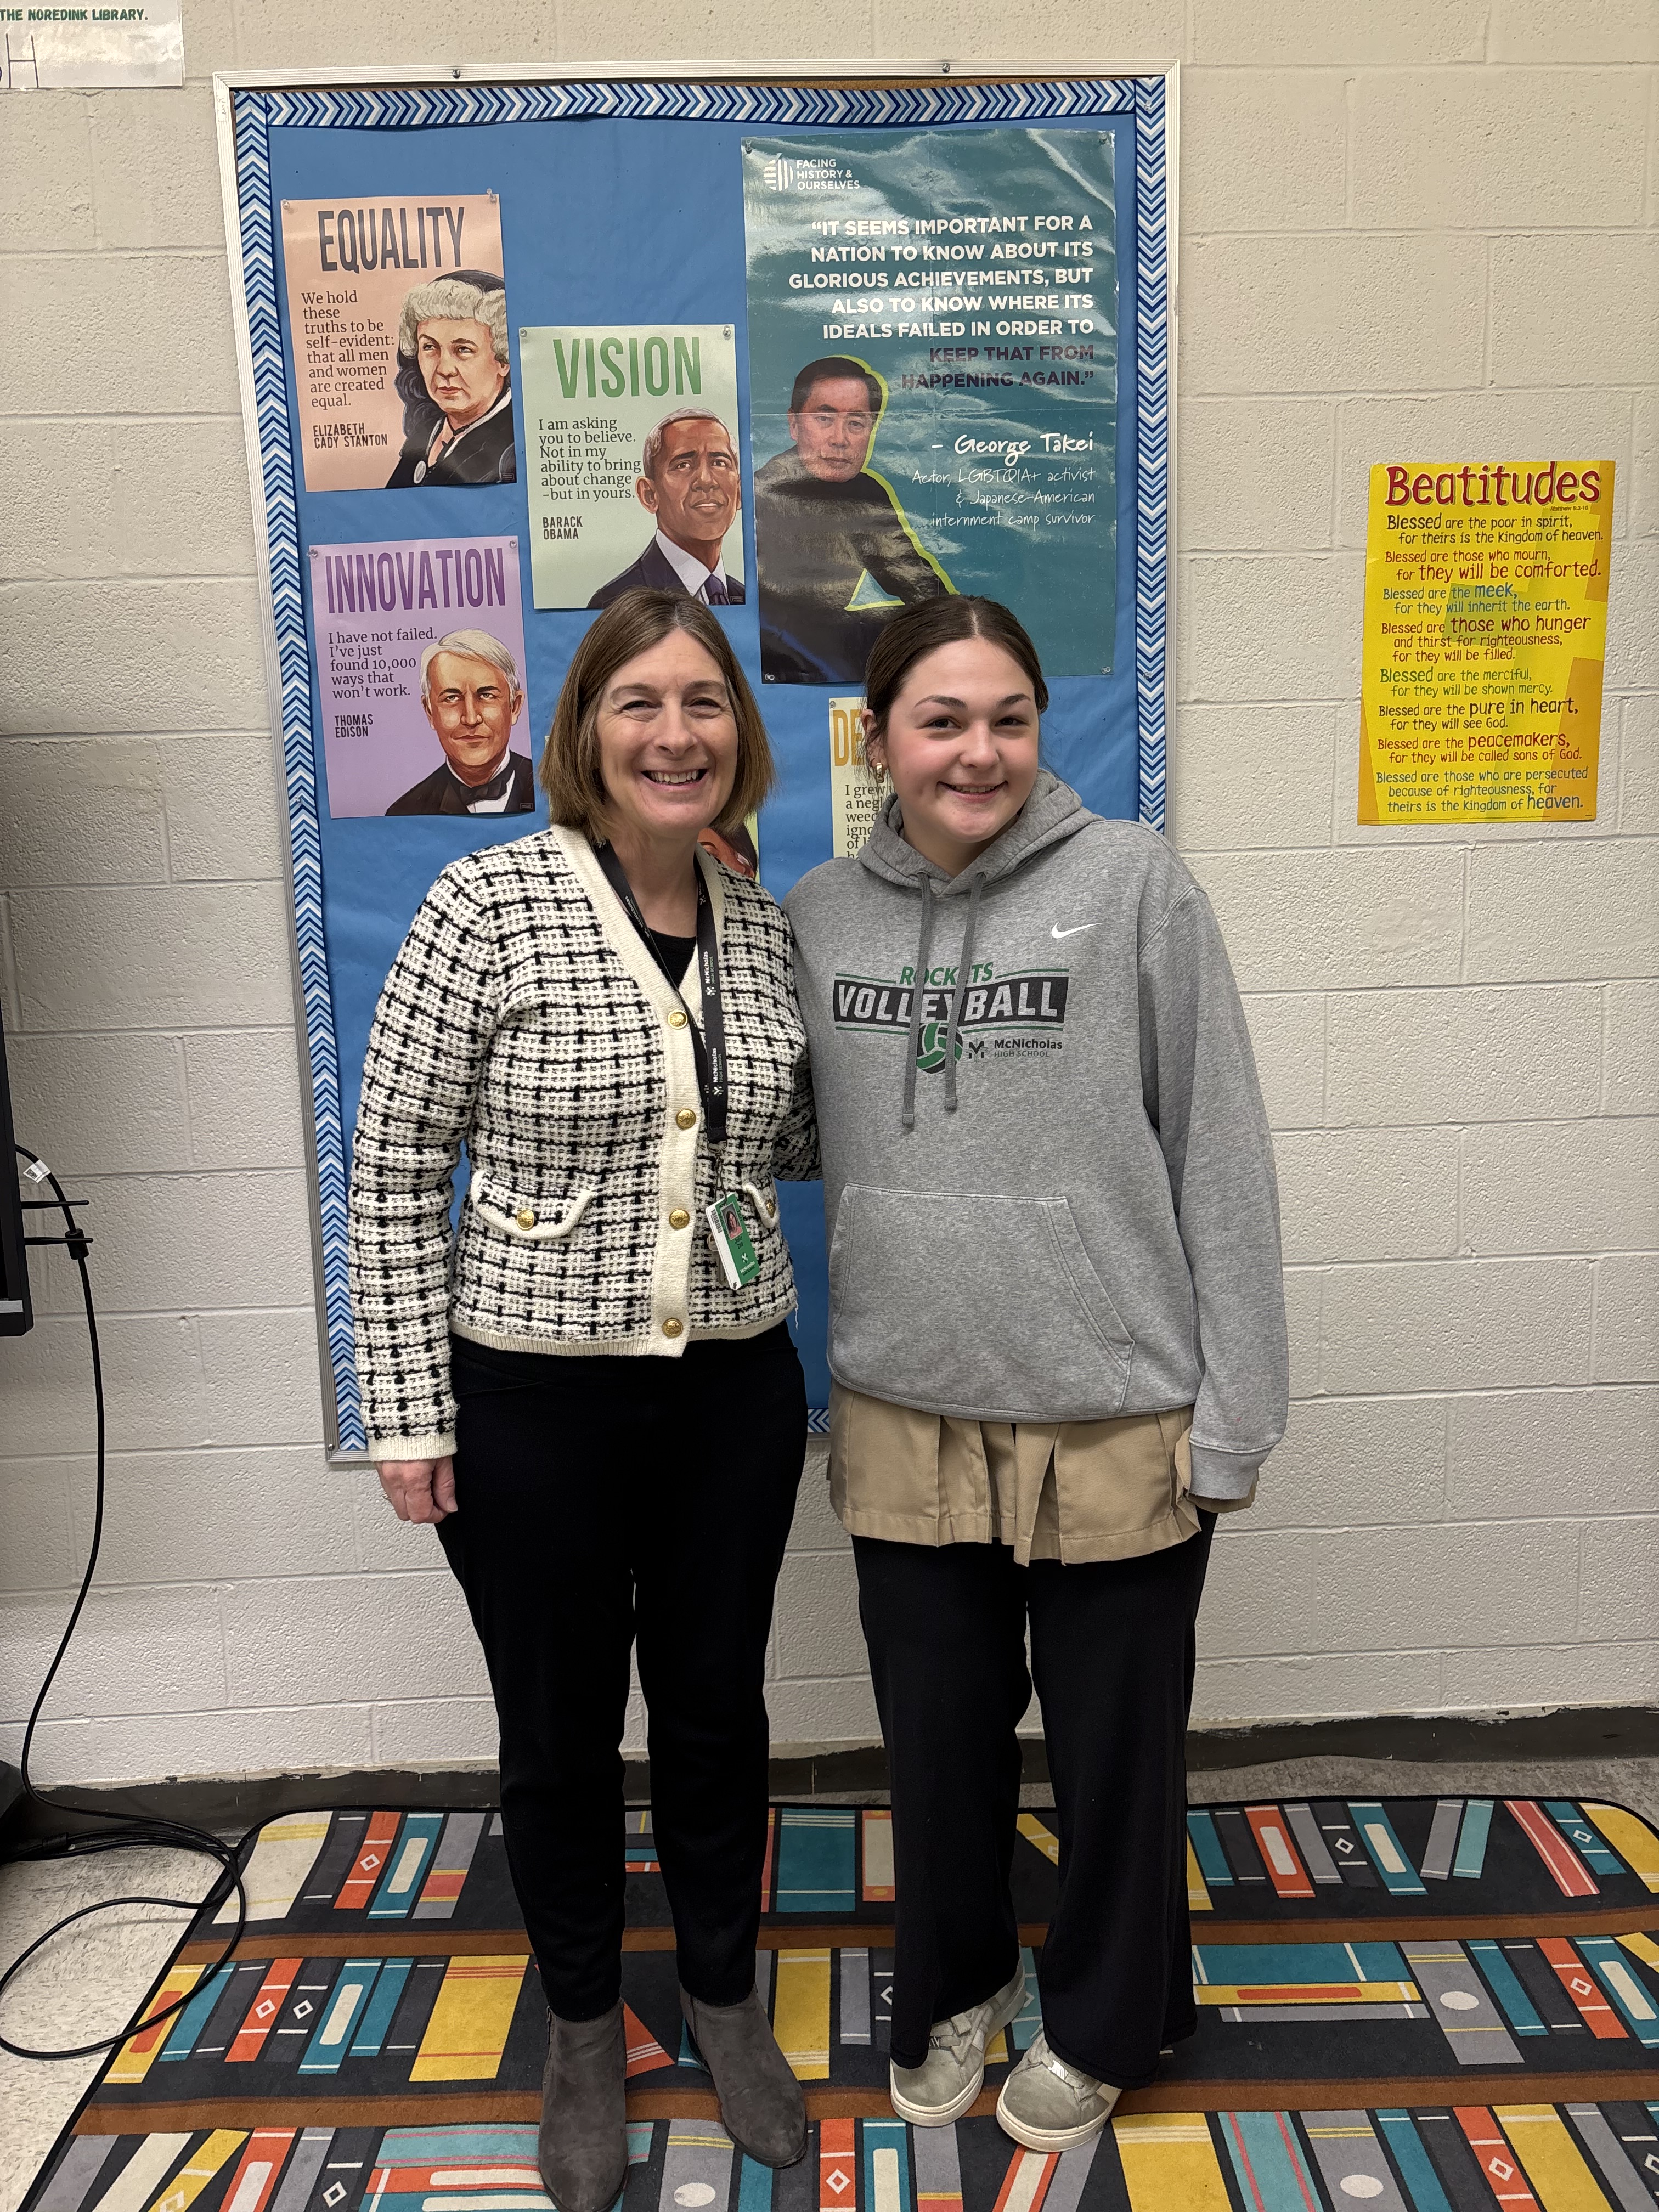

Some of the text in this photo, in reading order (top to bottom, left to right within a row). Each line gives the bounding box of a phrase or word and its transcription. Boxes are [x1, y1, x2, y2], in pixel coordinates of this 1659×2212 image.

[0, 9, 148, 21] THE NOREDINK LIBRARY.
[797, 159, 837, 168] FACING
[797, 170, 842, 179] HISTORY
[797, 180, 860, 190] OURSELVES
[845, 219, 909, 235] SEEMS
[915, 217, 1029, 234] IMPORTANT
[1034, 216, 1074, 231] FOR
[1079, 215, 1093, 230] A
[318, 207, 465, 274] EQUALITY
[811, 241, 1093, 262] NATION TO KNOW ABOUT ITS
[789, 268, 1093, 289] GLORIOUS ACHIEVEMENTS, BUT
[301, 291, 358, 305] We hold
[831, 294, 1093, 314] ALSO TO KNOW WHERE ITS
[303, 307, 340, 319] these
[305, 319, 383, 334] truths to be
[823, 319, 1094, 340] IDEALS FAILED IN ORDER TO
[306, 334, 395, 348] self-evident:
[307, 351, 389, 363] that all men
[930, 345, 1093, 362] KEEP THAT FROM
[309, 365, 387, 378] and women
[553, 336, 702, 398] VISION
[310, 378, 384, 393] are created
[901, 372, 1013, 388] HAPPENING
[312, 394, 352, 410] equal.
[313, 423, 365, 437] ELIZABETH
[539, 417, 617, 432] I am asking
[314, 434, 388, 449] CADY STANTON
[539, 431, 636, 447] you to believe.
[540, 447, 606, 459] Not in my
[955, 435, 1031, 466] George
[1040, 431, 1093, 453] Takei
[540, 459, 641, 475] ability to bring
[541, 473, 632, 488] about change
[912, 466, 1096, 487] Actor, LGBTQIA+ activist
[1385, 461, 1601, 506] Beatitudes
[577, 488, 590, 499] in
[594, 488, 635, 502] yours.
[956, 488, 1094, 511] & Japanese-American
[543, 516, 583, 528] BARACK
[933, 510, 1095, 532] internment camp survivor
[1387, 513, 1573, 532] Blessed are the poor in spirit,
[543, 528, 579, 540] OBAMA
[1396, 559, 1601, 583] for they will be comforted.
[325, 548, 505, 613] INNOVATION
[1383, 582, 1517, 600] Blessed are the meek,
[329, 627, 437, 644] I have not failed.
[329, 645, 382, 659] I've just
[331, 658, 416, 672] found 10,000
[332, 672, 394, 687] ways that
[332, 685, 410, 699] won't work.
[1379, 697, 1578, 718] Blessed are the pure in heart,
[335, 714, 373, 726] THOMAS
[335, 726, 369, 738] EDISON
[1378, 732, 1570, 751] Blessed are the peacemakers,
[1376, 767, 1588, 783] Blessed are those who are persecuted
[845, 785, 850, 795] I
[854, 786, 885, 798] grew
[847, 836, 860, 849] of
[900, 962, 993, 986] ROCKTS
[994, 1039, 1063, 1049] McNicholas
